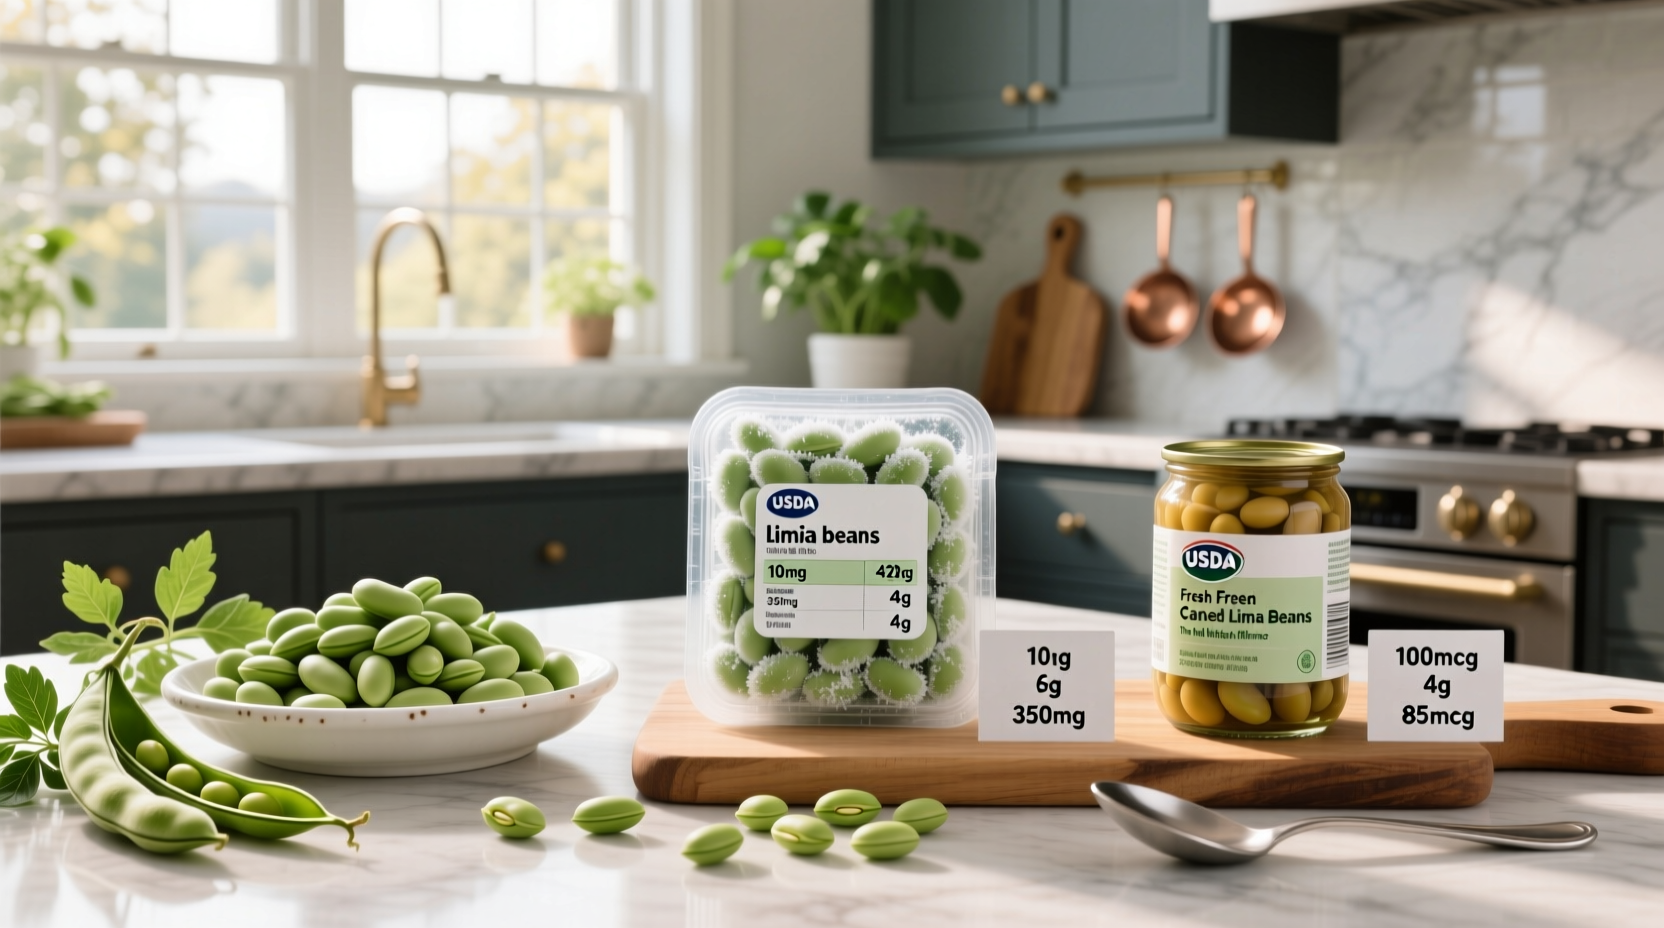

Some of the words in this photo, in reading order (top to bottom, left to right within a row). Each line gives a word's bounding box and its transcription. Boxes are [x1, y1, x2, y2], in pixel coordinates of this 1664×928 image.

[772, 495, 815, 510] USDA
[766, 524, 817, 544] Limia
[822, 524, 880, 544] beans
[1185, 550, 1237, 570] USDA
[767, 563, 807, 583] 10mg
[889, 589, 911, 608] 4g
[1180, 587, 1212, 604] Fresh
[1216, 589, 1257, 605] Freen
[889, 613, 911, 634] 4g
[1179, 605, 1225, 623] Caned
[1228, 608, 1265, 624] Lima
[1267, 609, 1313, 624] Beans
[1395, 645, 1478, 672] 100mcg
[1036, 673, 1062, 699] 6g
[1423, 674, 1451, 699] 4g
[1012, 704, 1086, 730] 350mg
[1401, 704, 1475, 730] 85mcg
